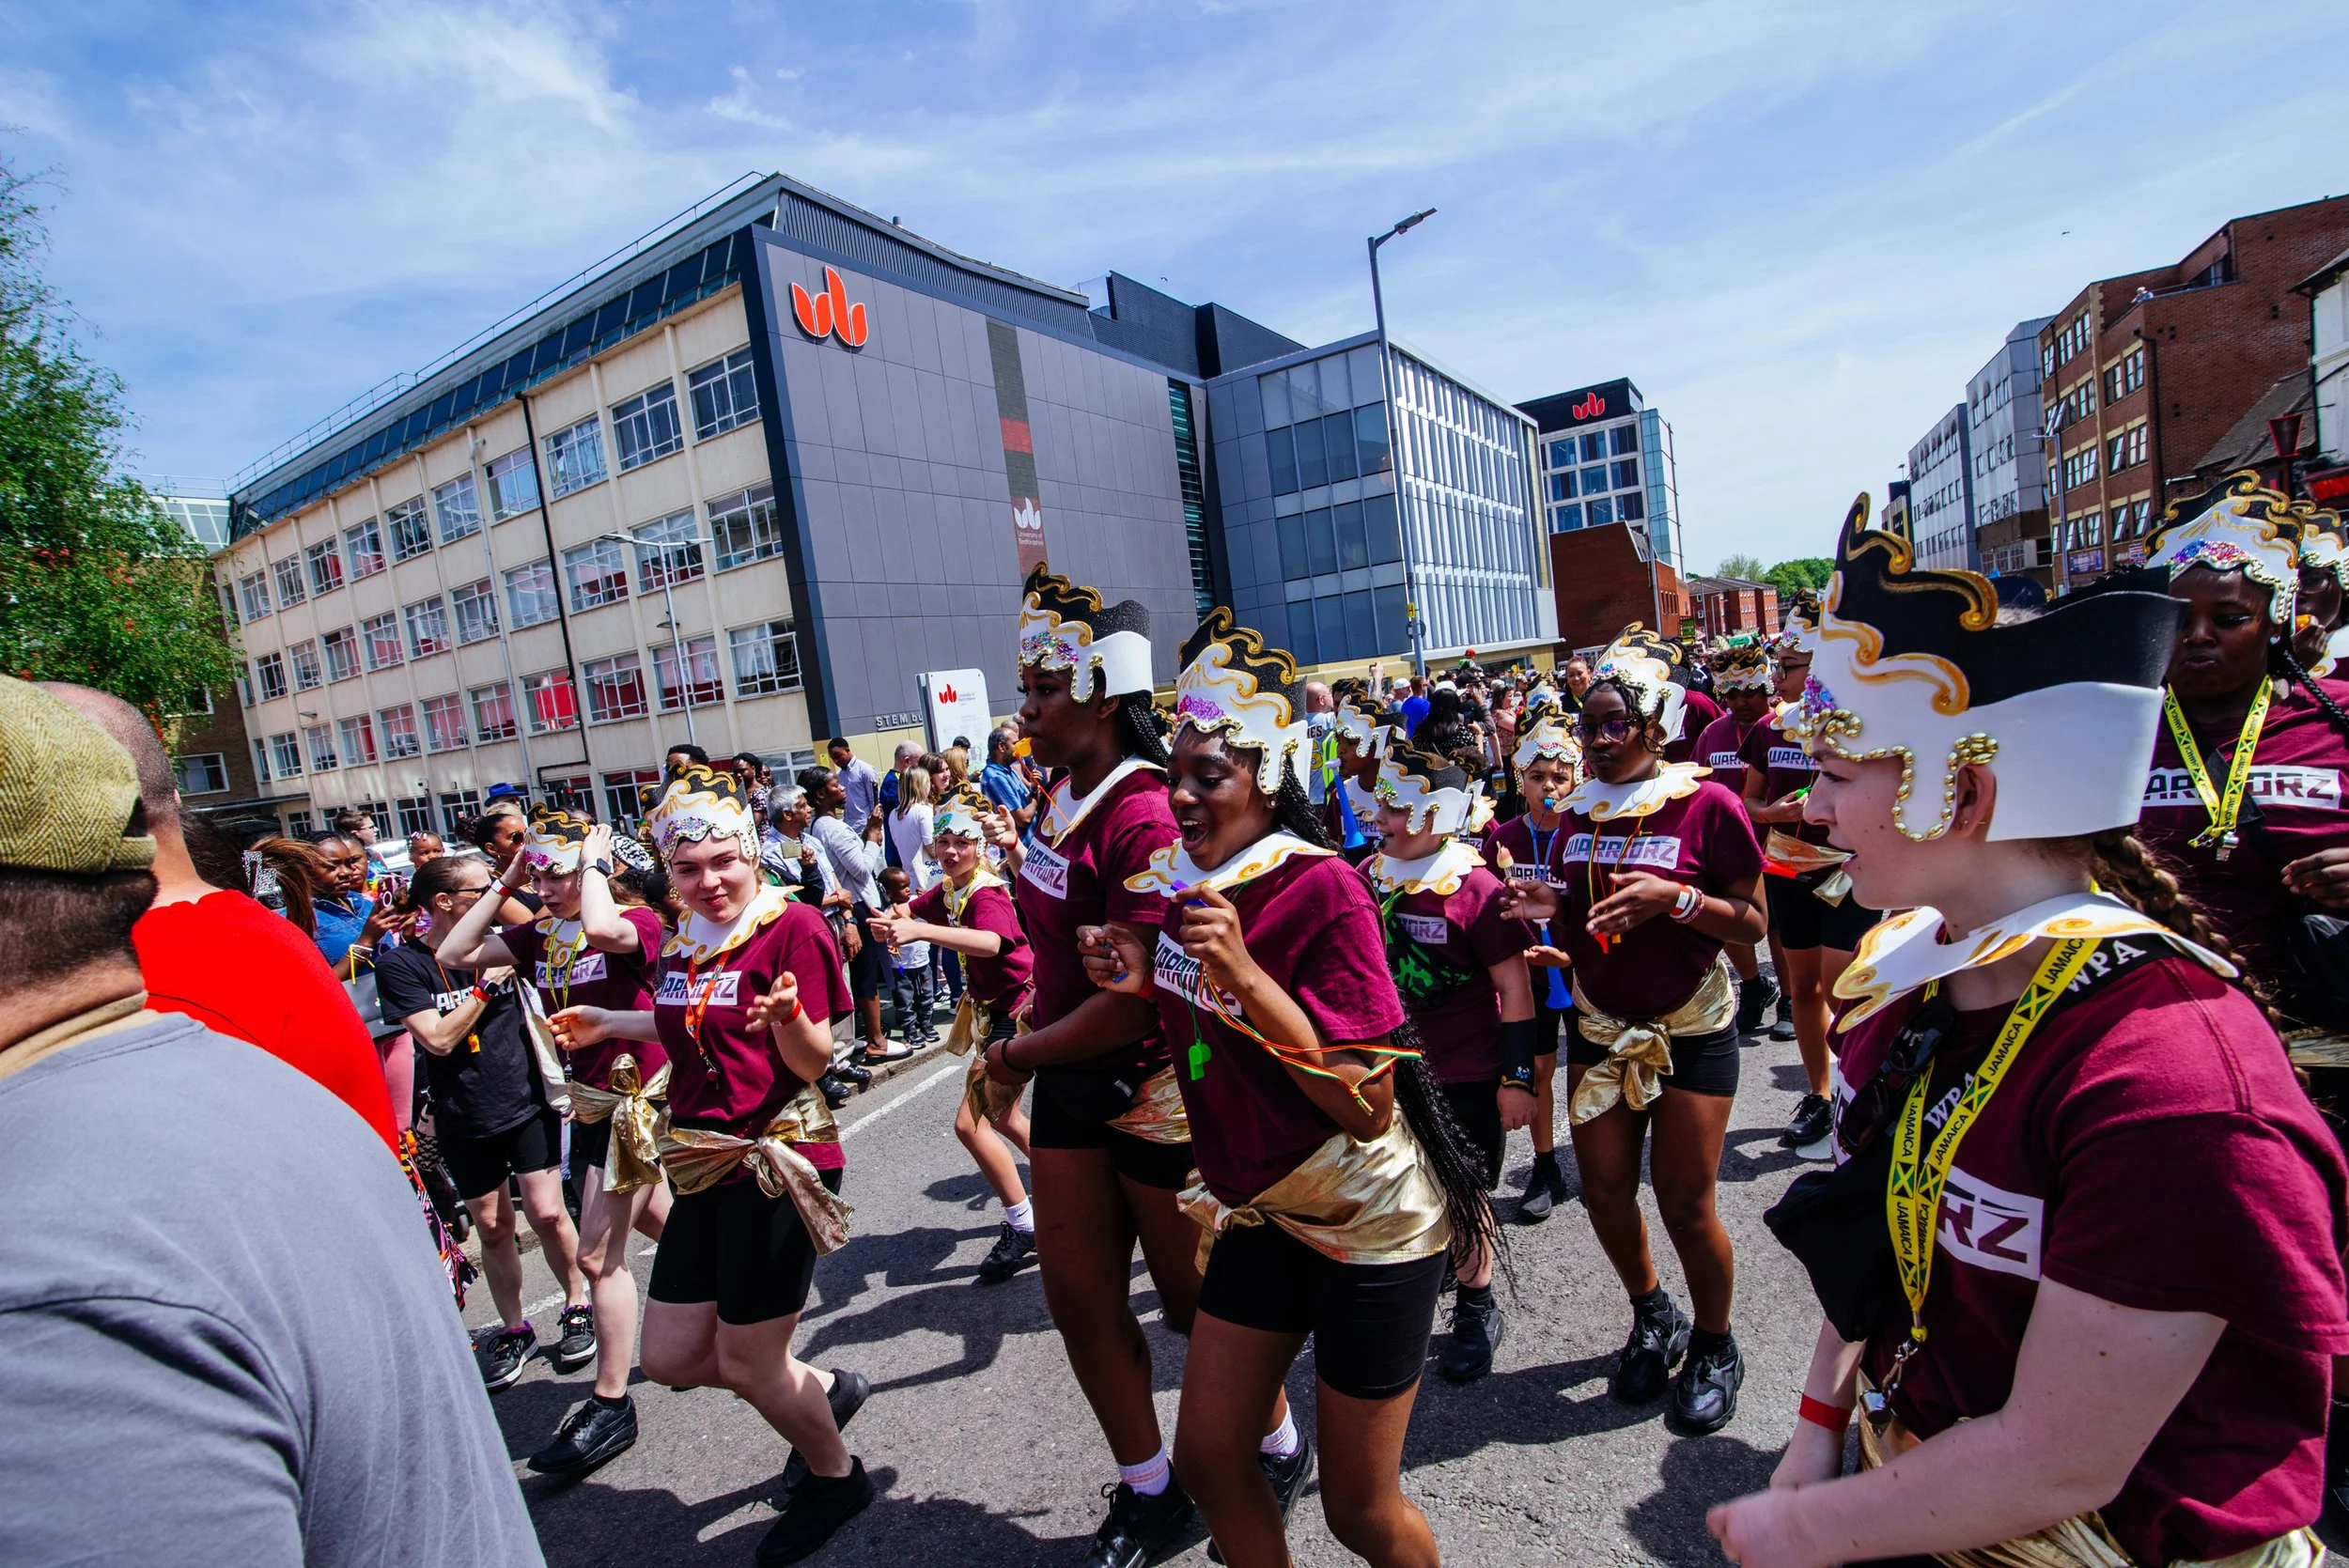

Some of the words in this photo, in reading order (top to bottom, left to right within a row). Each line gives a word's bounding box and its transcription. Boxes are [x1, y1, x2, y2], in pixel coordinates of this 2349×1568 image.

[876, 713, 908, 727] STEM
[1985, 1022, 2025, 1077] JAMAICA
[1902, 1102, 1919, 1157] JAMAICA
[1934, 1114, 1969, 1166] JAMAICA
[1895, 1202, 1914, 1256] JAMAICA
